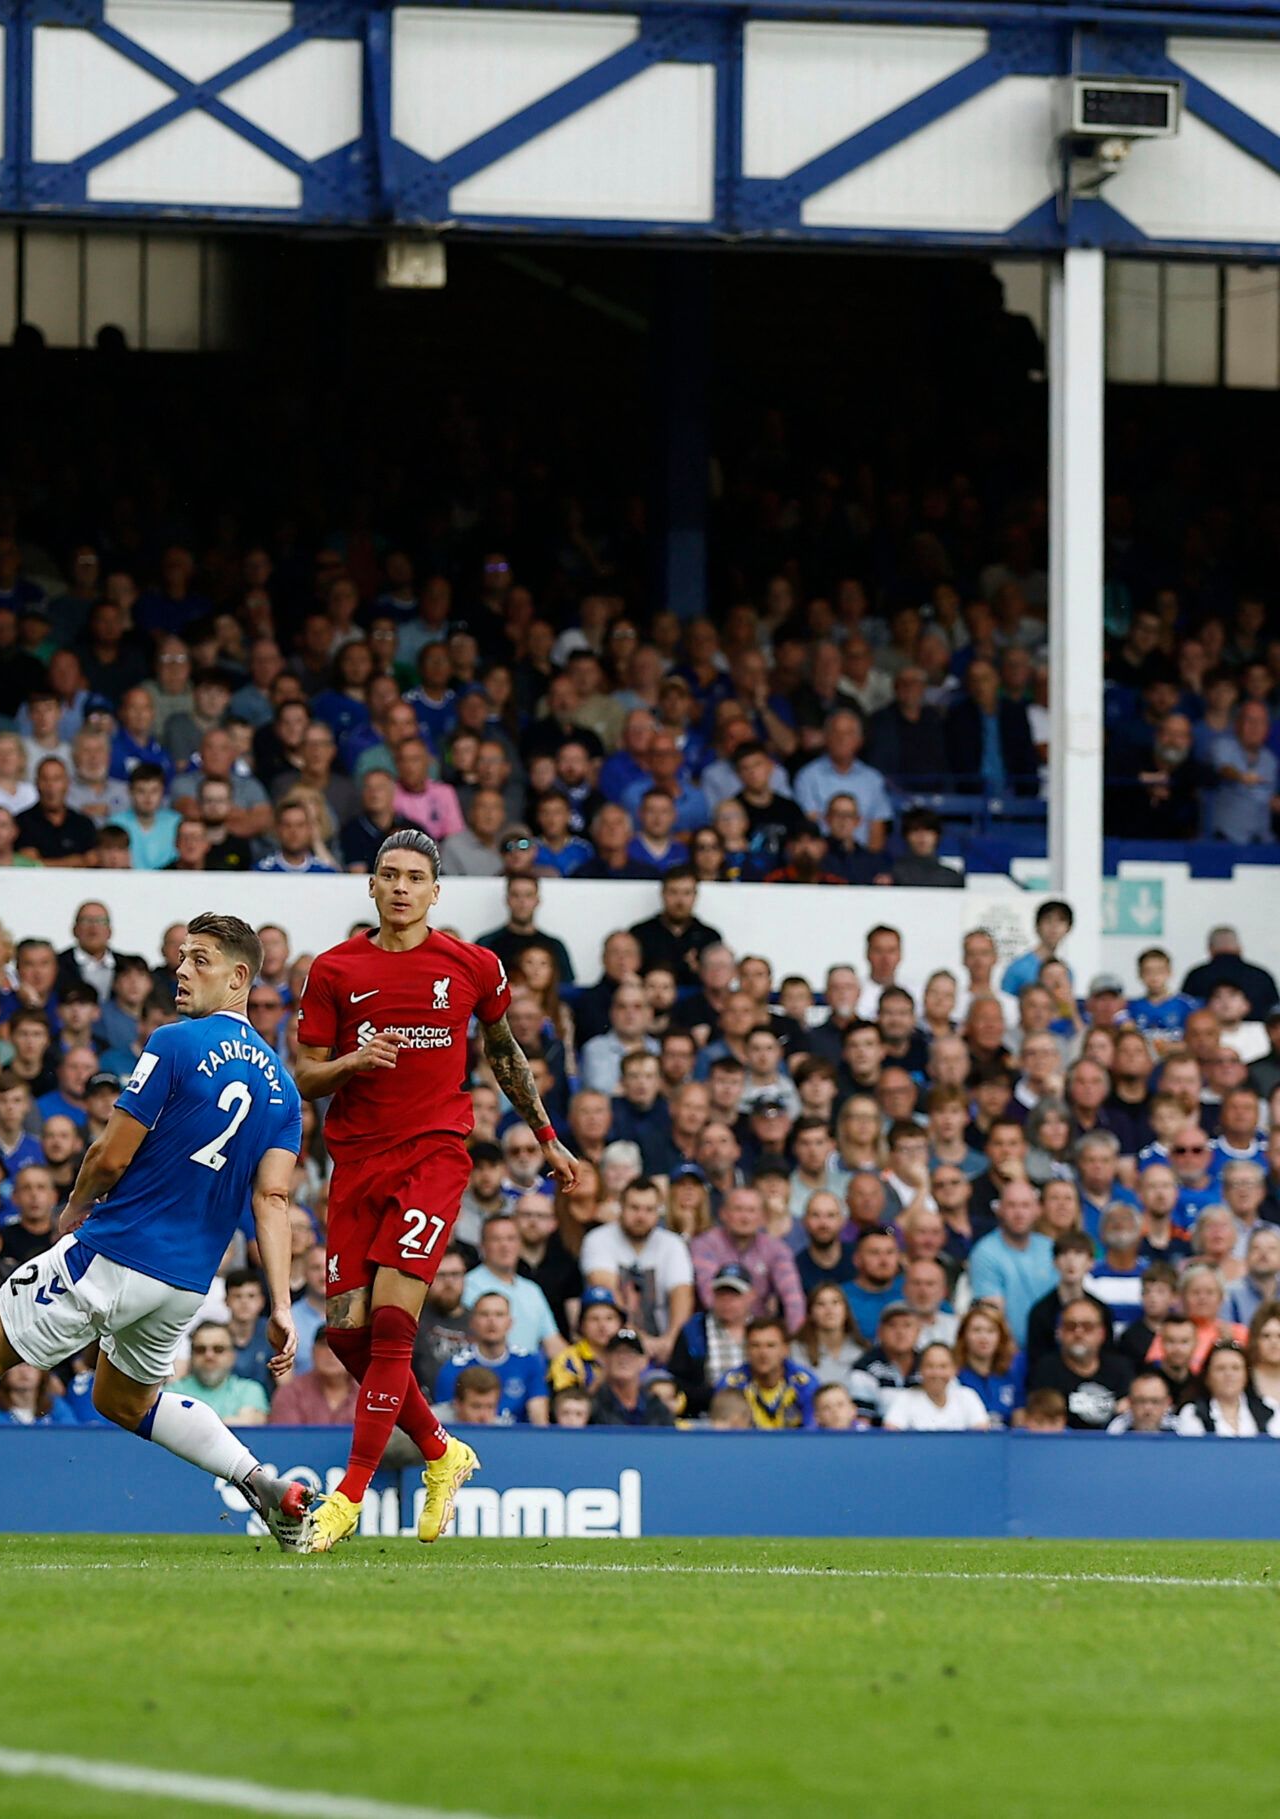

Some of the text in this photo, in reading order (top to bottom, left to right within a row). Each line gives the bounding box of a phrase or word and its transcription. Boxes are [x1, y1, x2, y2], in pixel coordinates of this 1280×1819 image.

[432, 1000, 450, 1009] LFC
[189, 1080, 252, 1171] 2
[398, 1208, 446, 1255] 27
[10, 1264, 39, 1297] 2
